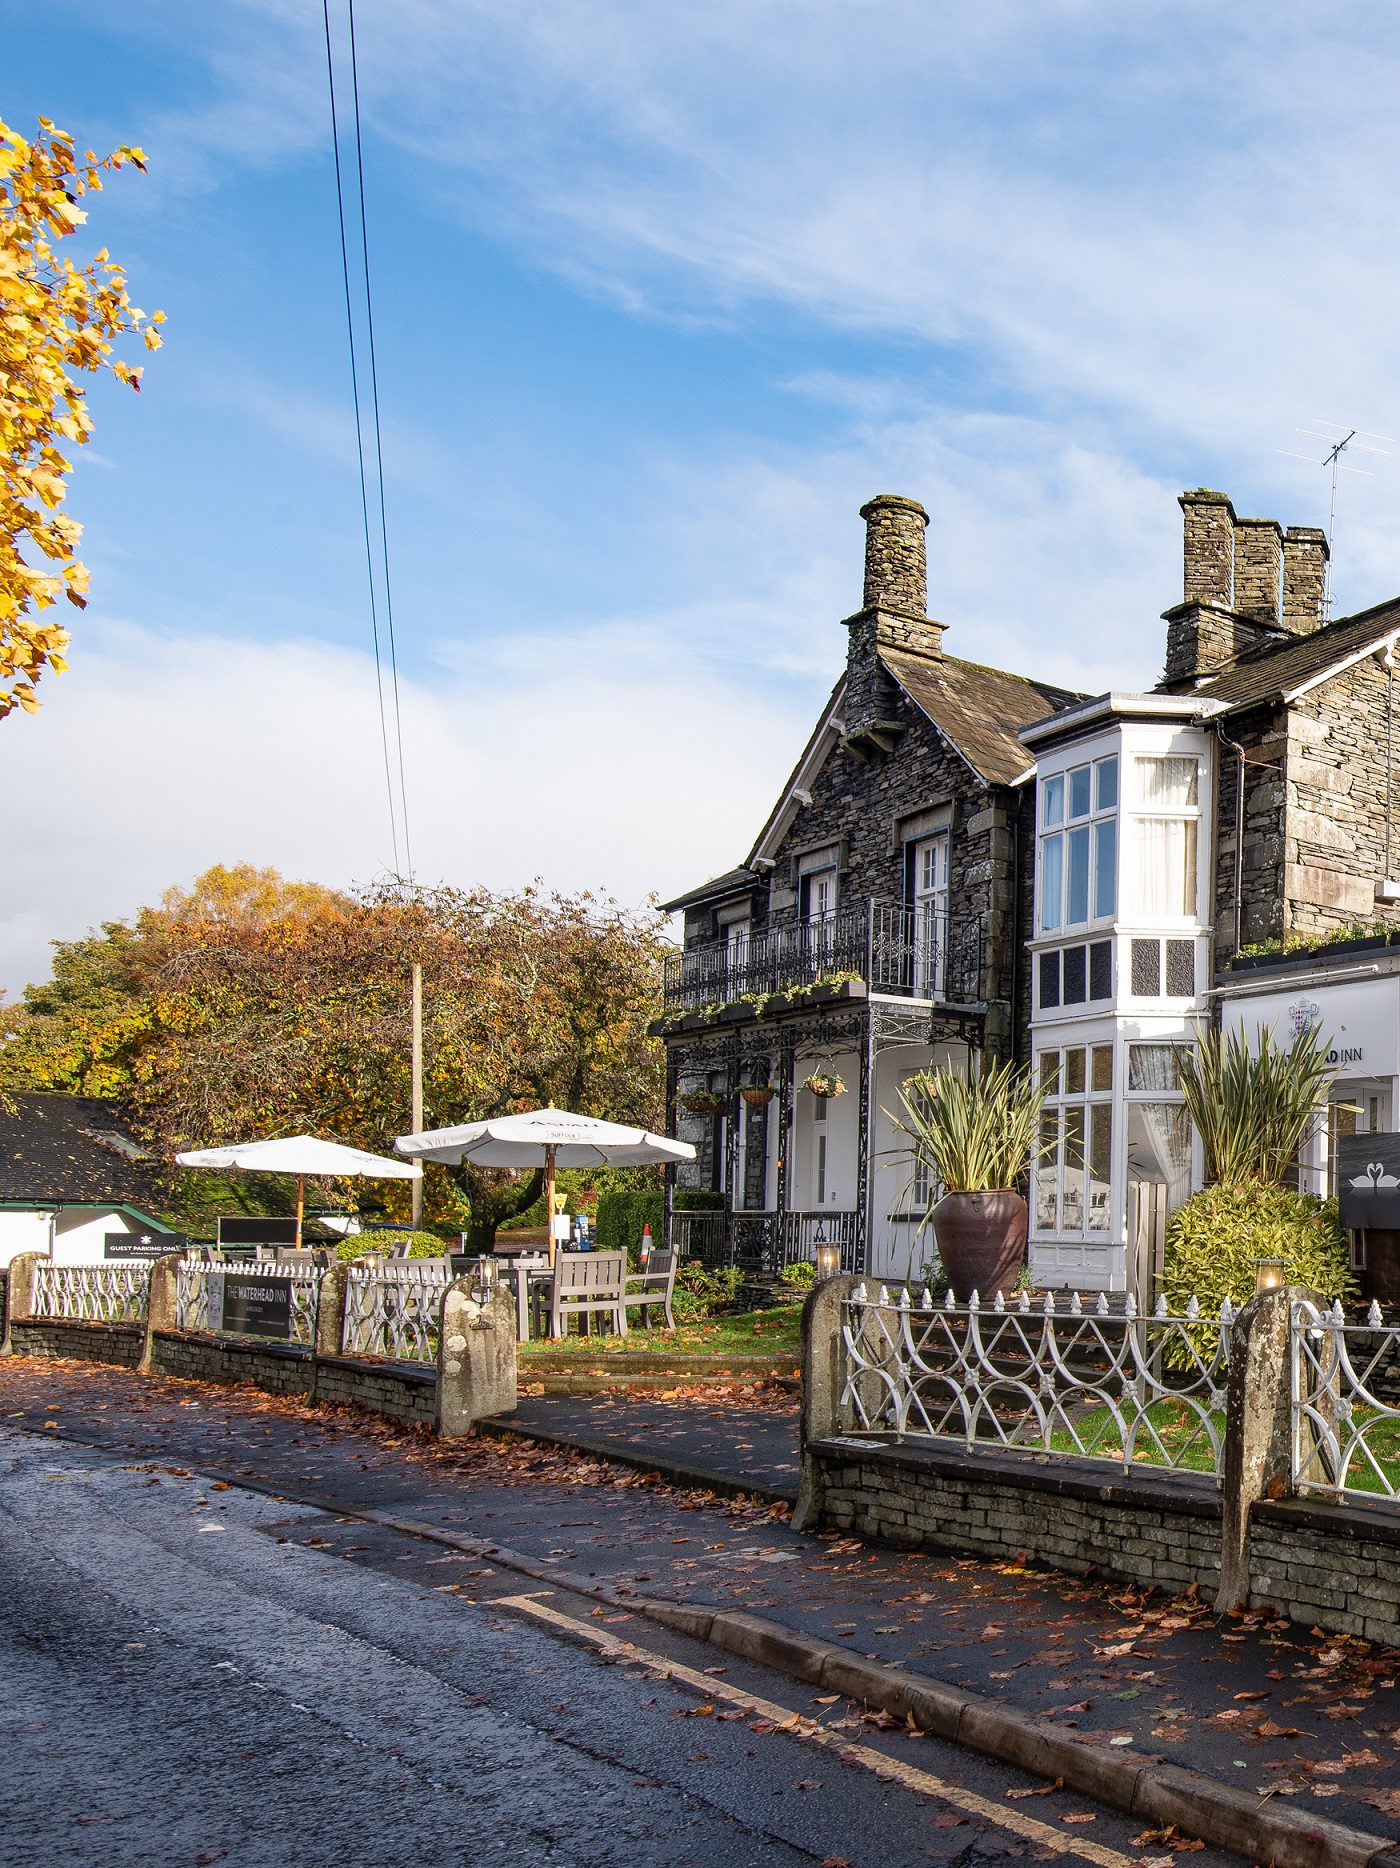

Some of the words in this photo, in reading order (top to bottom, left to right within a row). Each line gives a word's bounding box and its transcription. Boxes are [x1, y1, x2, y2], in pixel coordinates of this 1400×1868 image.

[1341, 1047, 1362, 1062] INN
[227, 1285, 238, 1299] THE
[238, 1286, 274, 1302] WATERHEAD
[275, 1291, 287, 1303] INN
